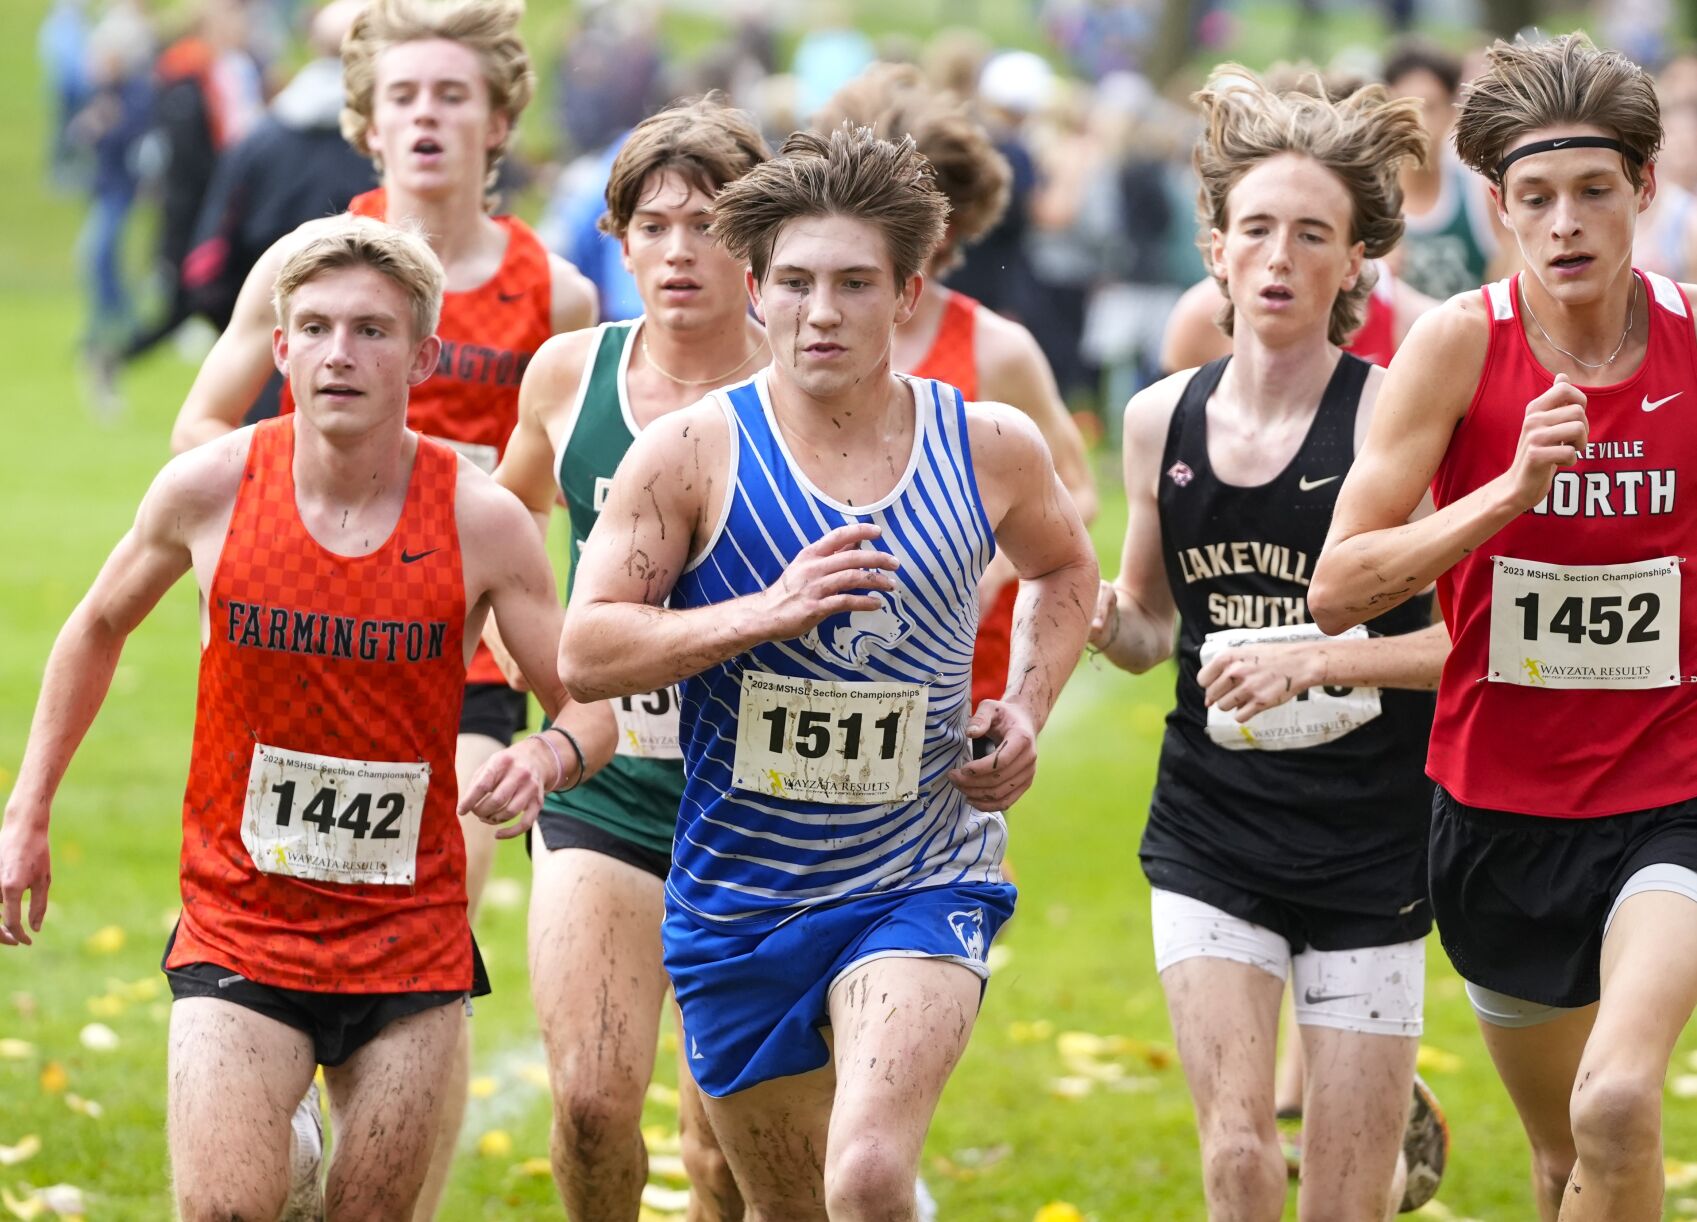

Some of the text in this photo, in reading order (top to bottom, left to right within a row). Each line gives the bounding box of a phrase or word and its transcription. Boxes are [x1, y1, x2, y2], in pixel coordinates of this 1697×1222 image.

[1177, 541, 1312, 587] LAKEVILL
[1503, 565, 1672, 582] 2023 MSHSL Section Championships
[1207, 592, 1306, 629] SOUTH
[1514, 592, 1661, 646] 1452
[227, 601, 449, 662] FARMINGTON
[1540, 664, 1651, 676] WAYZATA RESULTS
[752, 680, 920, 700] 2023 MSHSL Section Championships
[762, 706, 902, 760] 1511
[1253, 725, 1303, 738] WAYZATA
[263, 754, 421, 781] 2023 MSHSL Section Championships
[783, 777, 838, 792] WAYZATA
[842, 781, 890, 792] RESULTS
[271, 779, 405, 839] 1442
